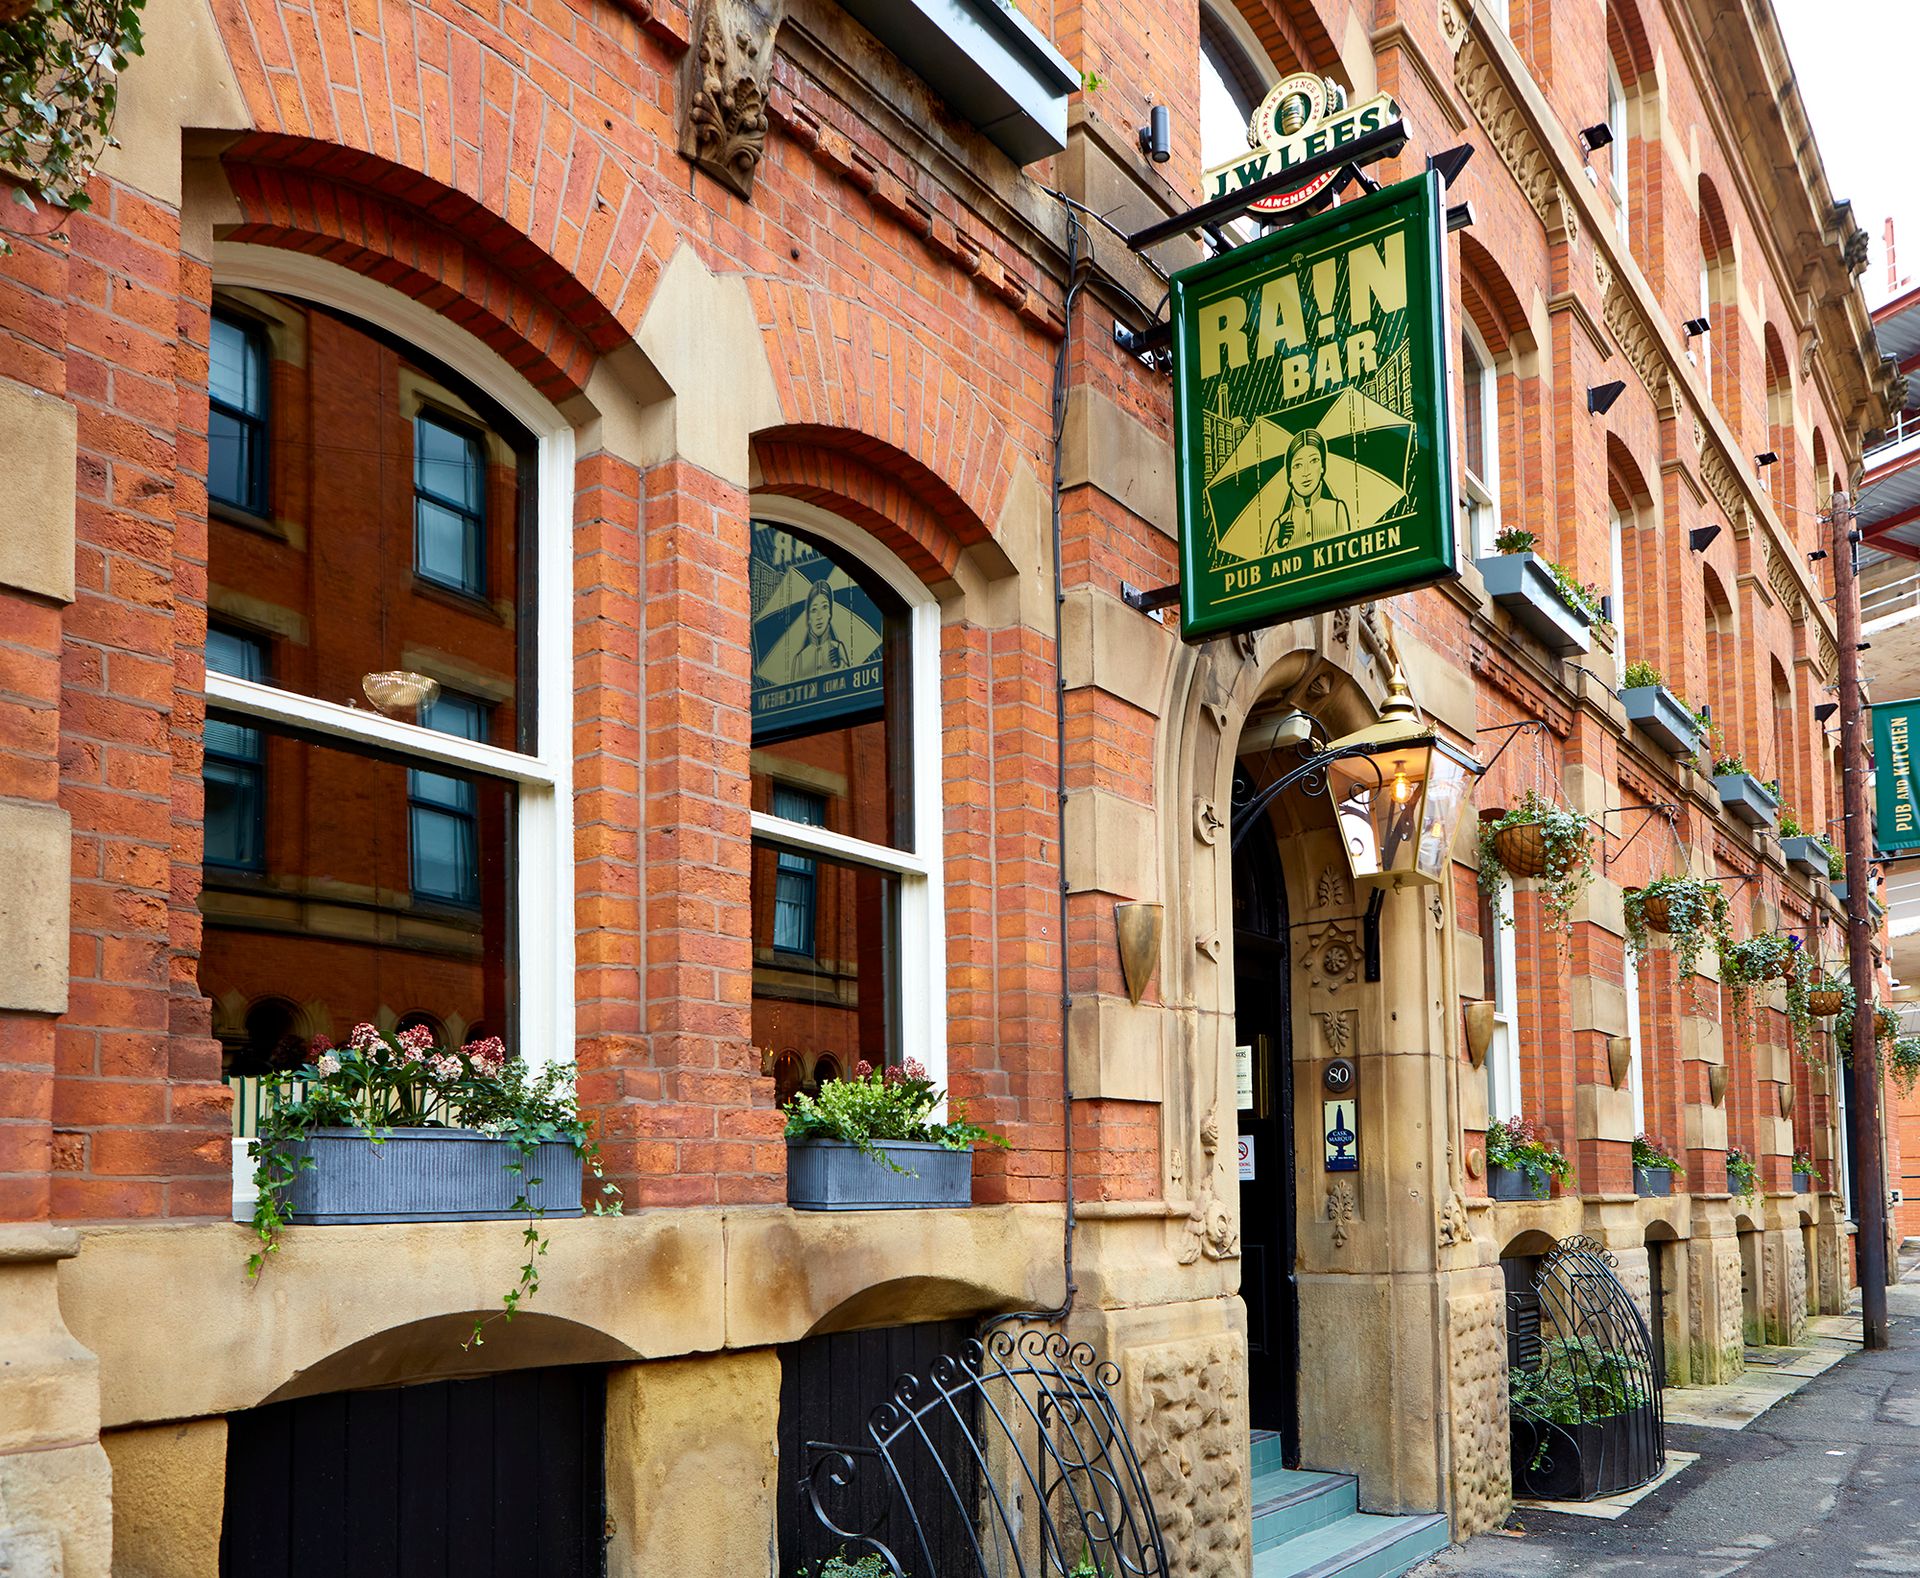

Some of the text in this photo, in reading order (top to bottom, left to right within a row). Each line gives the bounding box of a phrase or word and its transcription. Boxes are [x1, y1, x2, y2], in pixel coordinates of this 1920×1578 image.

[1289, 81, 1317, 93] SINCE
[1199, 231, 1407, 380] RA!N
[1283, 330, 1377, 400] BAR
[1224, 526, 1401, 592] PUB AND KITCHEN
[1890, 716, 1913, 832] PUB AND KITCHEN
[1328, 1067, 1349, 1084] 80
